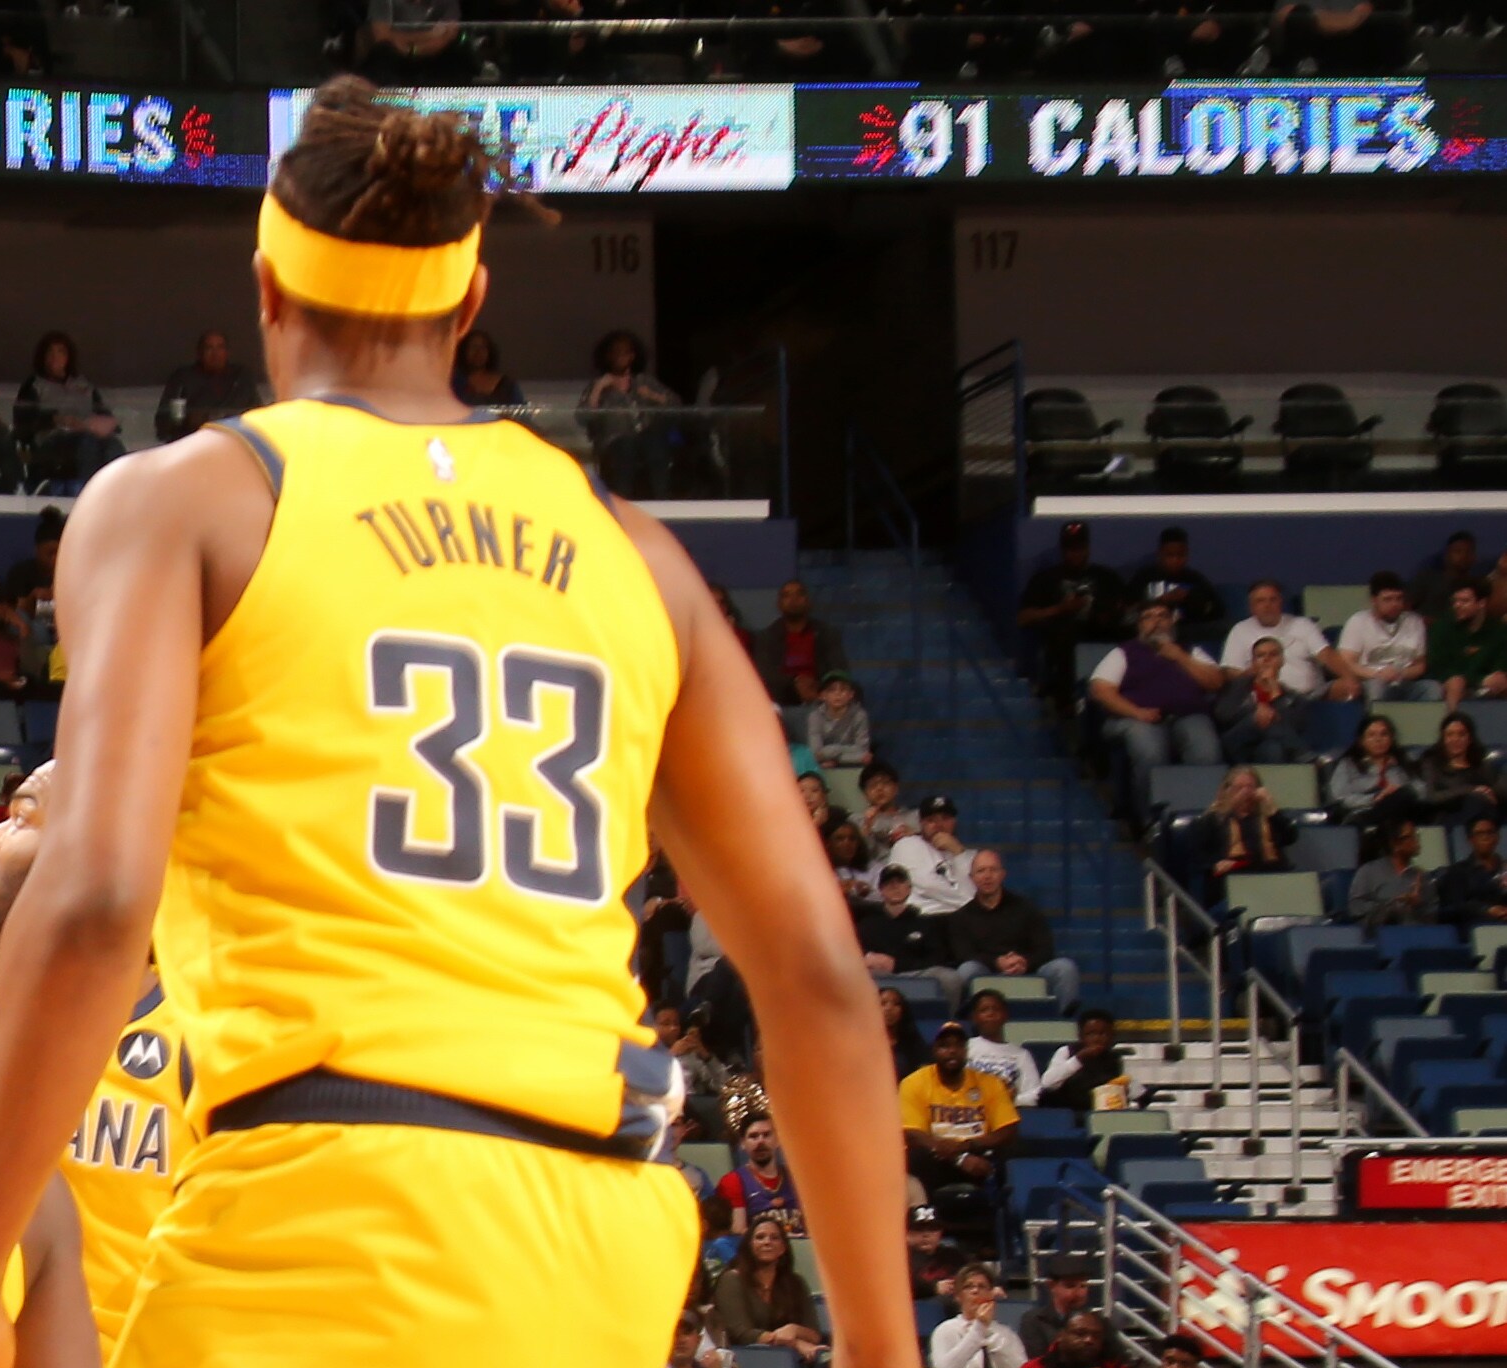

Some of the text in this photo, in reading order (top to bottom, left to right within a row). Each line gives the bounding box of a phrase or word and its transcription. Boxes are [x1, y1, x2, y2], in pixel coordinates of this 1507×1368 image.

[898, 96, 1441, 177] 91 CALORIES
[589, 234, 640, 274] 116
[969, 230, 1019, 271] 117
[354, 498, 579, 594] TURNER
[367, 627, 610, 904] 33
